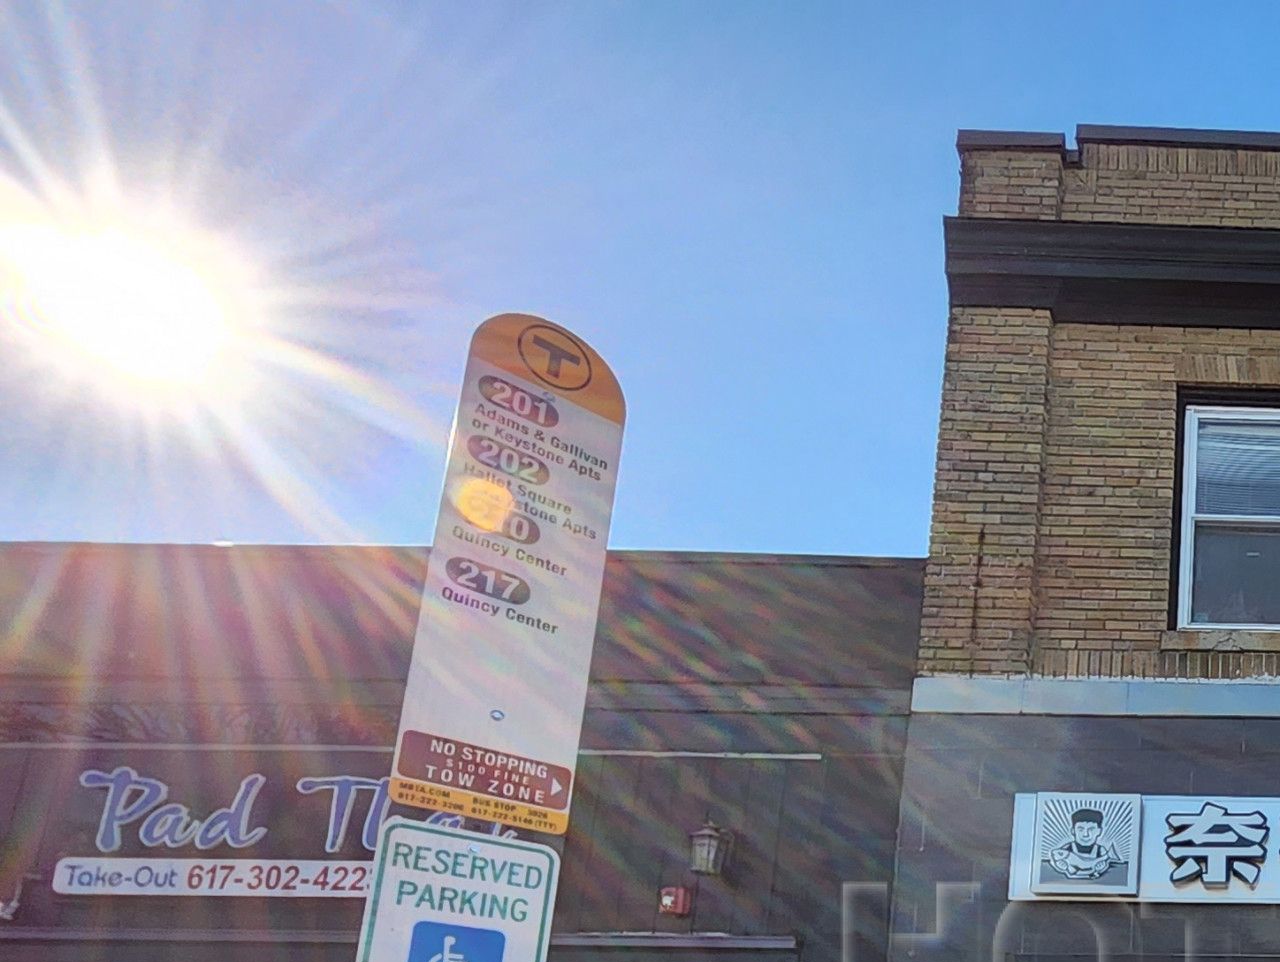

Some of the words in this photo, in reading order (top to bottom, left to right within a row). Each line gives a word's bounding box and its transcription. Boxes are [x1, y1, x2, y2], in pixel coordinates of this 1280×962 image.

[491, 381, 547, 425] 201
[471, 418, 489, 431] or
[495, 427, 565, 465] Keystone
[568, 459, 601, 481] Apts
[475, 403, 529, 435] Adams
[534, 429, 545, 442] &
[550, 436, 608, 470] Gallivan
[478, 439, 541, 483] 202
[517, 484, 572, 514] Square
[452, 525, 510, 557] Quincy
[515, 548, 567, 576] Center
[562, 518, 597, 540] Apts
[457, 559, 522, 601] 217
[441, 586, 501, 617] Quincy
[505, 607, 558, 635] Center
[430, 739, 456, 756] NO
[461, 746, 548, 779] STOPPING
[494, 769, 530, 785] FINE
[425, 765, 474, 788] TOW
[488, 779, 545, 804] ZONE
[472, 797, 491, 807] BUS
[494, 801, 517, 812] STOP
[79, 766, 268, 852] Pad
[64, 864, 178, 889] Take-Out
[186, 864, 372, 892] 617-302-422
[391, 841, 543, 890] RESERVED
[395, 879, 530, 923] PARKING
